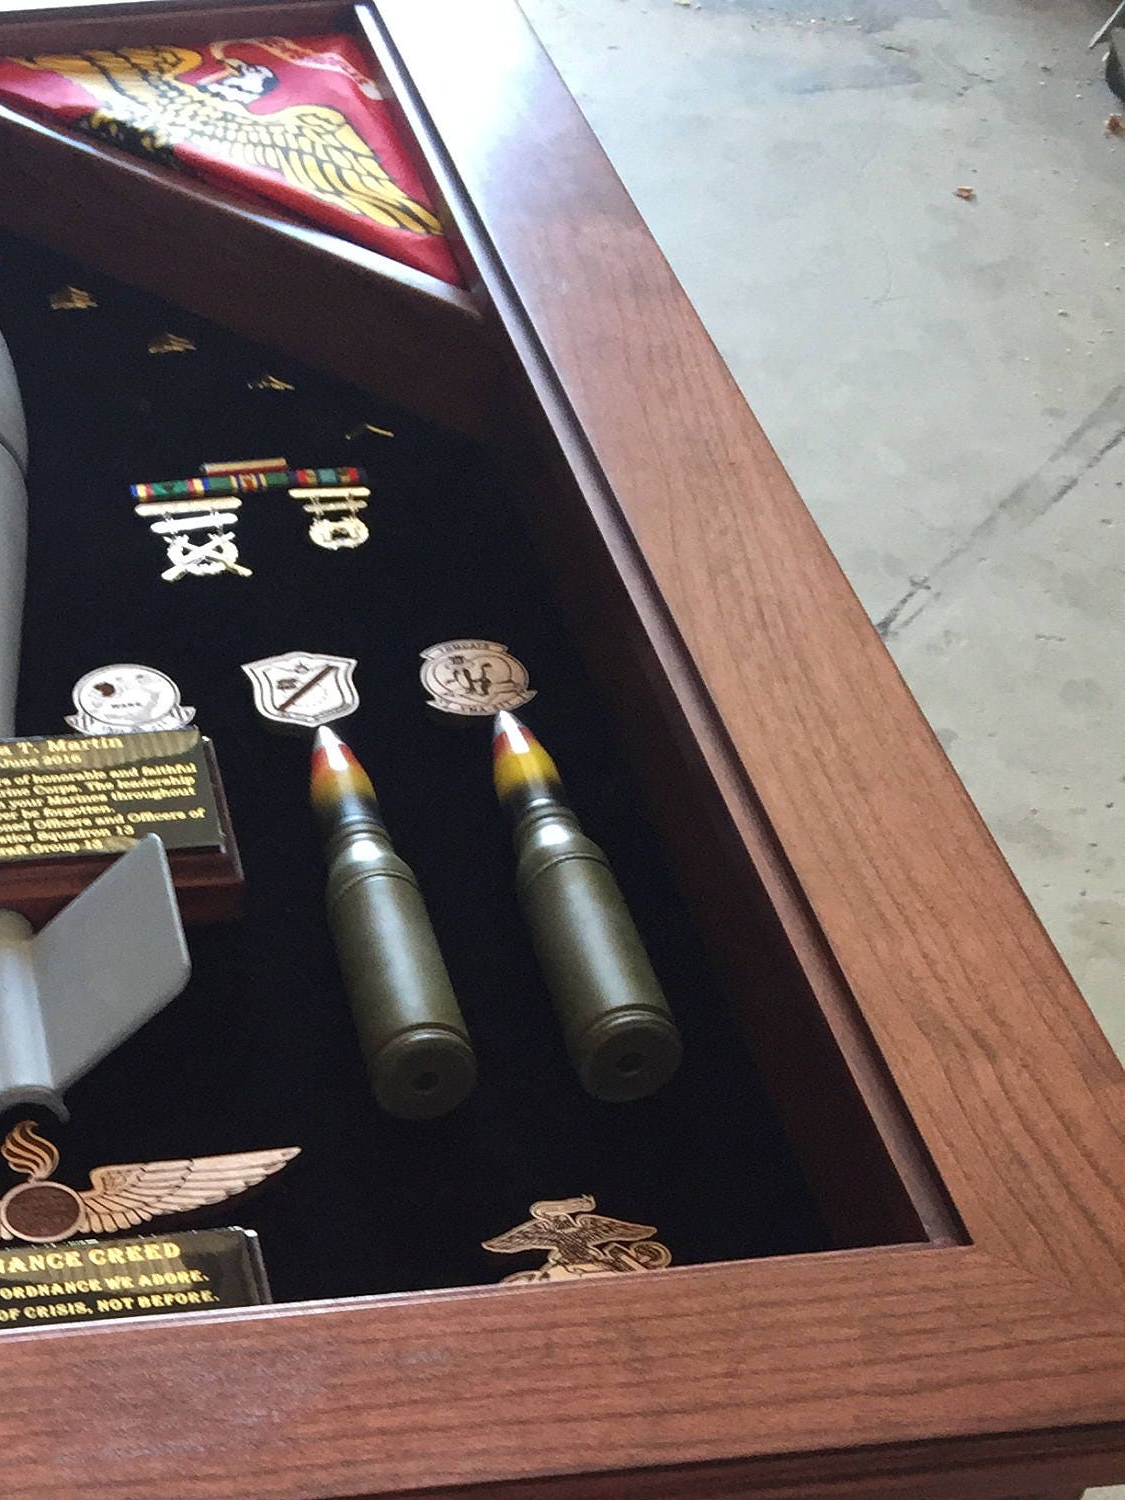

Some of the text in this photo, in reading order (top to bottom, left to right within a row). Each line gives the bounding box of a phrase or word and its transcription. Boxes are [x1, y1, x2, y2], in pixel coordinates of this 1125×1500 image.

[16, 741, 40, 755] T.
[46, 735, 124, 753] Martin
[13, 774, 31, 786] of
[32, 769, 107, 784] honorable
[109, 766, 140, 779] and
[141, 762, 197, 777] faithful
[84, 779, 115, 792] The
[116, 775, 197, 791] leadership
[8, 797, 45, 811] your
[46, 792, 108, 807] Marines
[110, 786, 197, 802] throughout
[20, 808, 40, 820] be
[33, 815, 93, 831] Officers
[94, 812, 126, 826] and
[126, 808, 187, 824] Officers
[188, 806, 206, 820] of
[36, 825, 112, 842] Squadron
[29, 840, 80, 856] Group
[88, 1241, 181, 1266] CREED
[104, 1275, 135, 1291] WE
[96, 1296, 135, 1313] NOT
